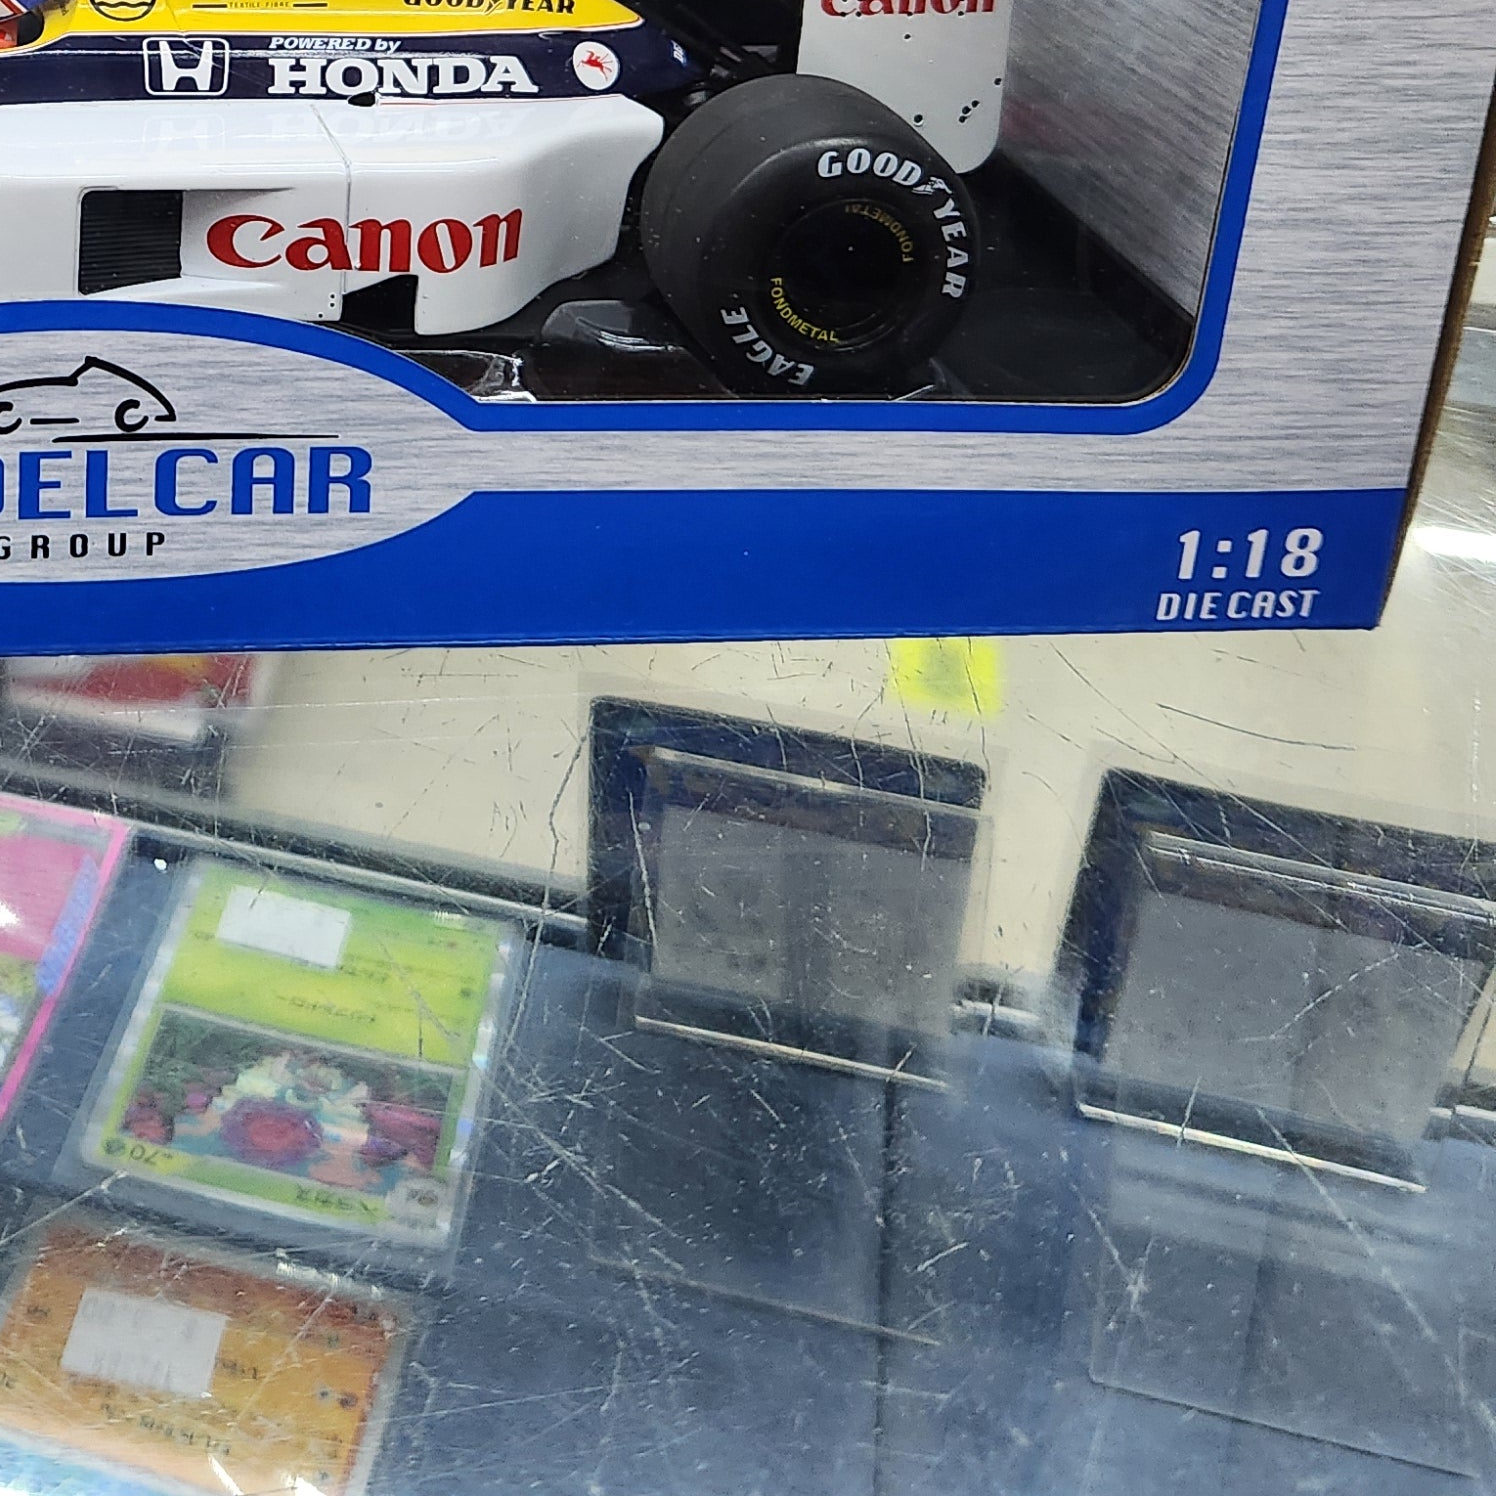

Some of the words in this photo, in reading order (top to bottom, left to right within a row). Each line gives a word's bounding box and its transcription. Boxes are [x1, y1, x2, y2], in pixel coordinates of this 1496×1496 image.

[269, 36, 371, 50] POWERED
[375, 38, 401, 53] by
[268, 56, 538, 94] HONDA
[207, 208, 522, 273] Canon
[770, 277, 840, 343] FONDMETAL
[720, 306, 814, 386] EAGLE
[1178, 528, 1324, 580] 1:18
